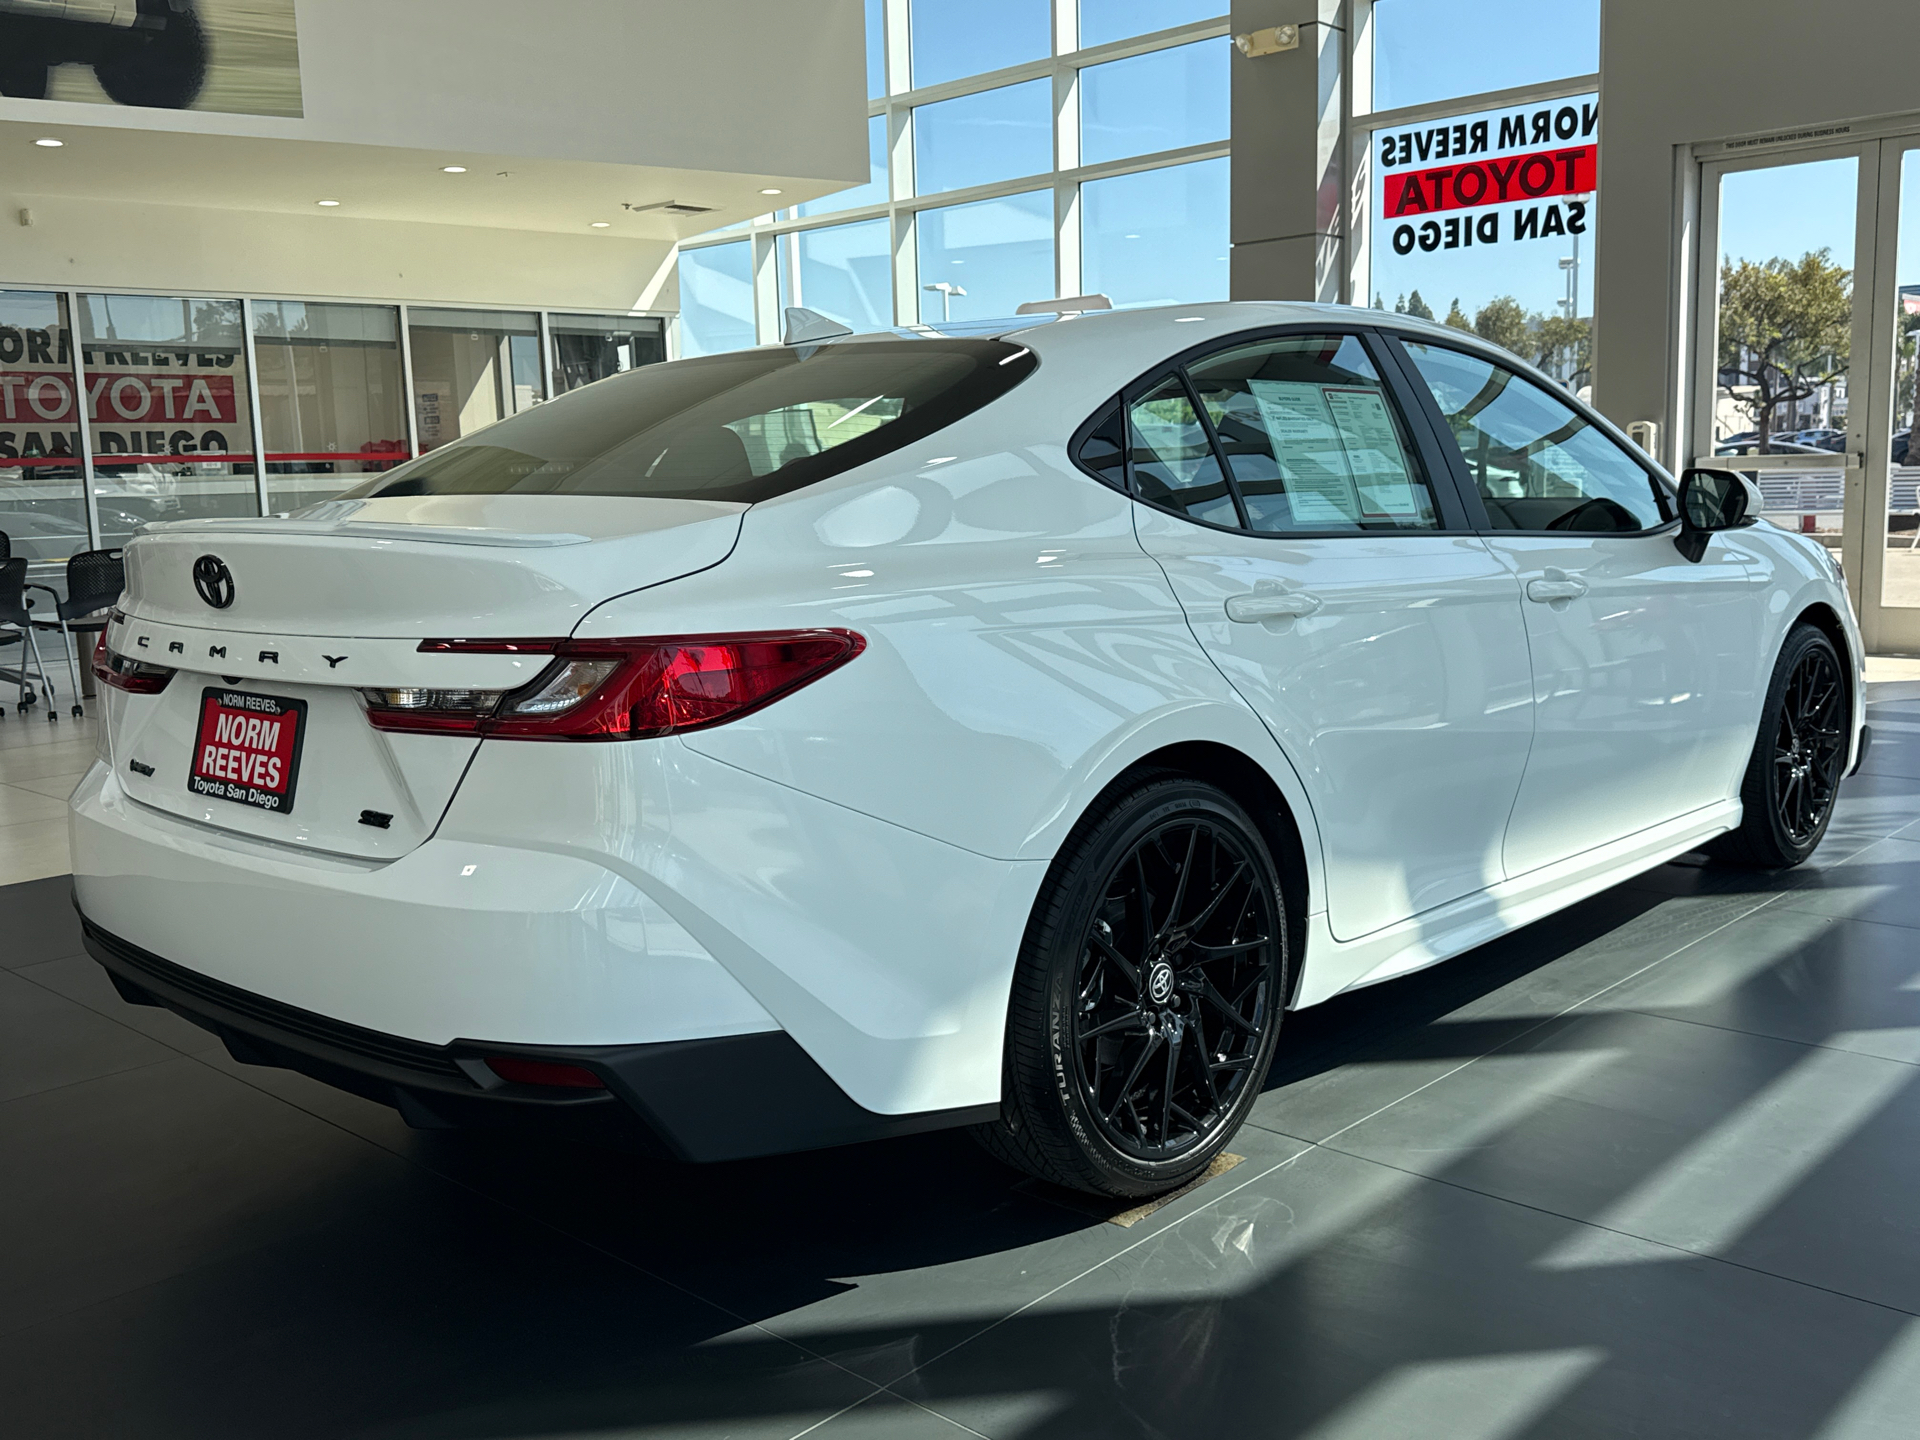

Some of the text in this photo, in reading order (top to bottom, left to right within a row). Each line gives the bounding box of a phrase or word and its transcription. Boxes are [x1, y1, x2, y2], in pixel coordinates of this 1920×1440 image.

[0, 375, 222, 420] TOYOTA
[98, 429, 229, 457] DIEGO
[137, 635, 349, 669] CAMRY
[223, 692, 276, 713] NORM REEVES
[214, 713, 281, 752] NORM
[201, 744, 281, 788] REEVES
[194, 776, 279, 809] Toyota San Diego
[1051, 972, 1072, 1107] TURANZA
